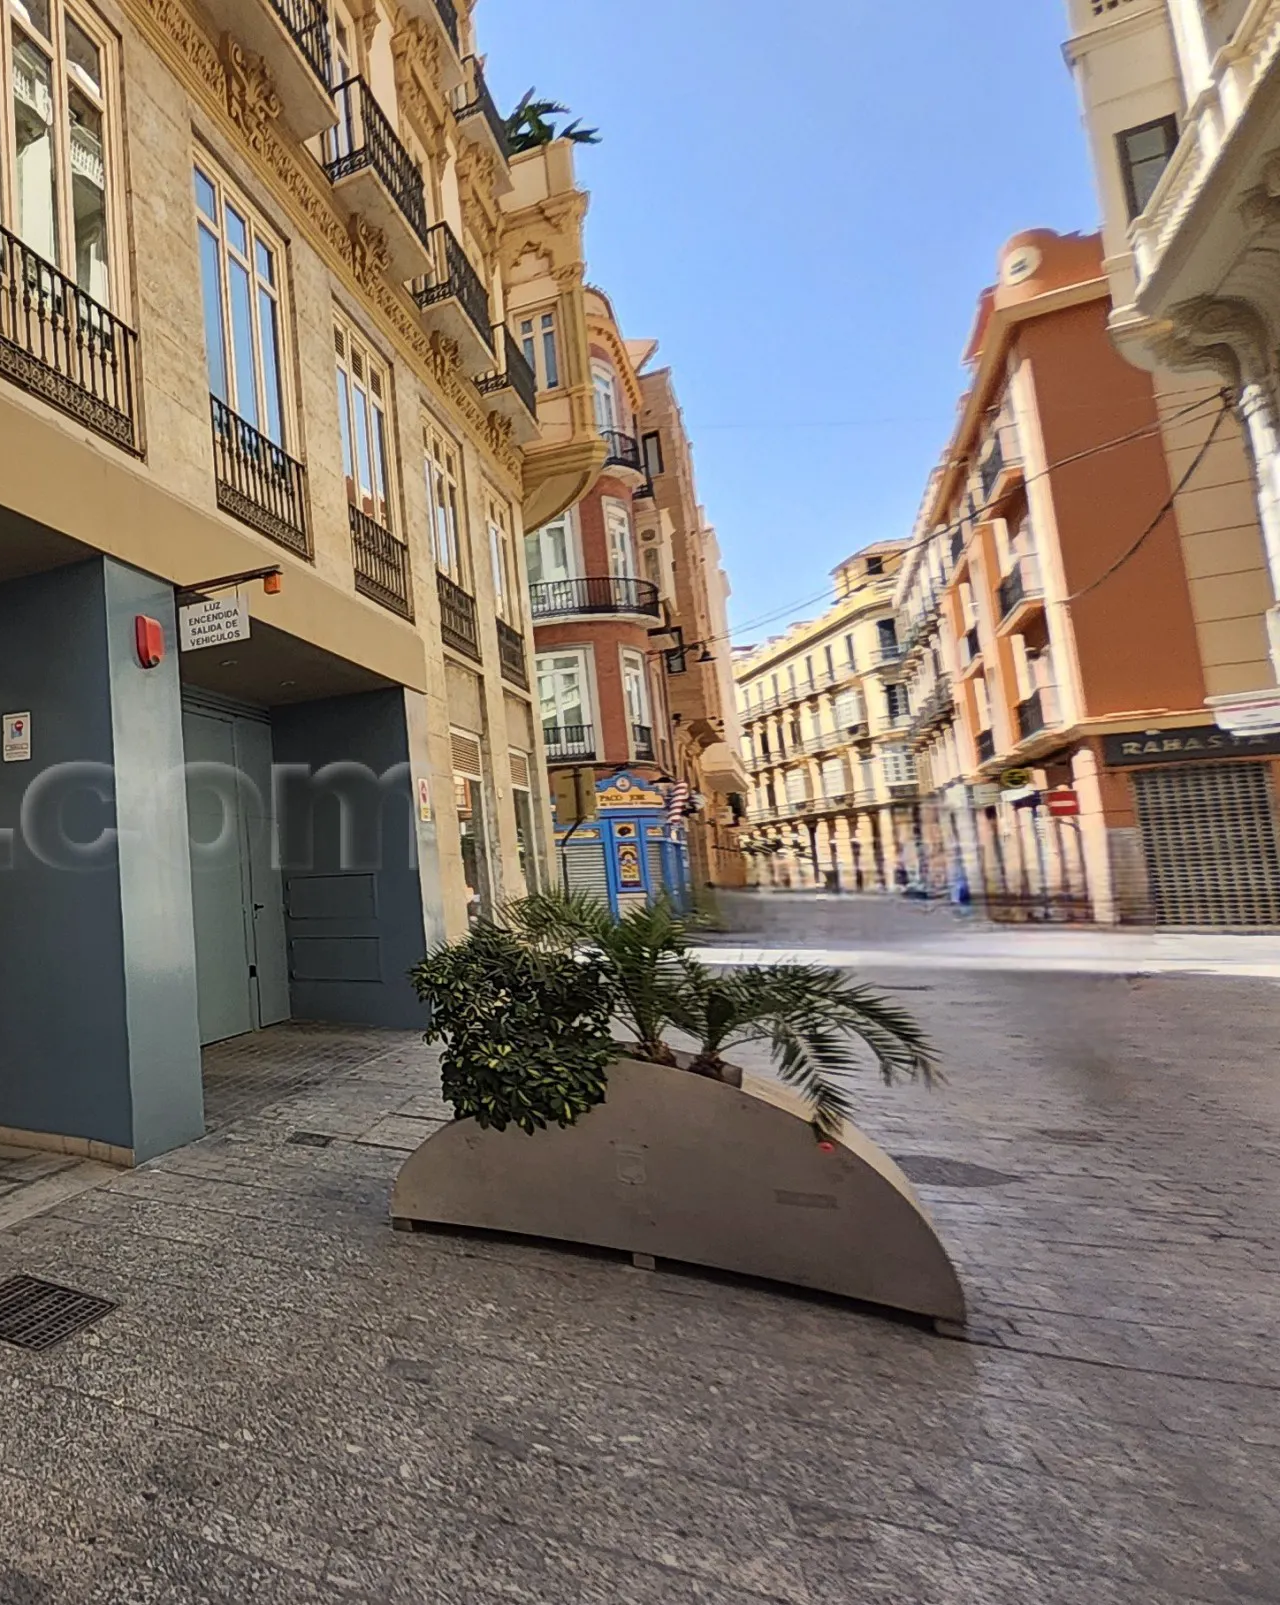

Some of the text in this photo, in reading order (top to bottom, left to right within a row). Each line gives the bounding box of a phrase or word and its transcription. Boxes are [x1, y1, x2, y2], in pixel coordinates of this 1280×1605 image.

[204, 602, 221, 612] LUZ
[189, 609, 238, 626] ENCENDIDA
[191, 620, 238, 636] SALIDA DE
[190, 631, 240, 647] VEHICULOS
